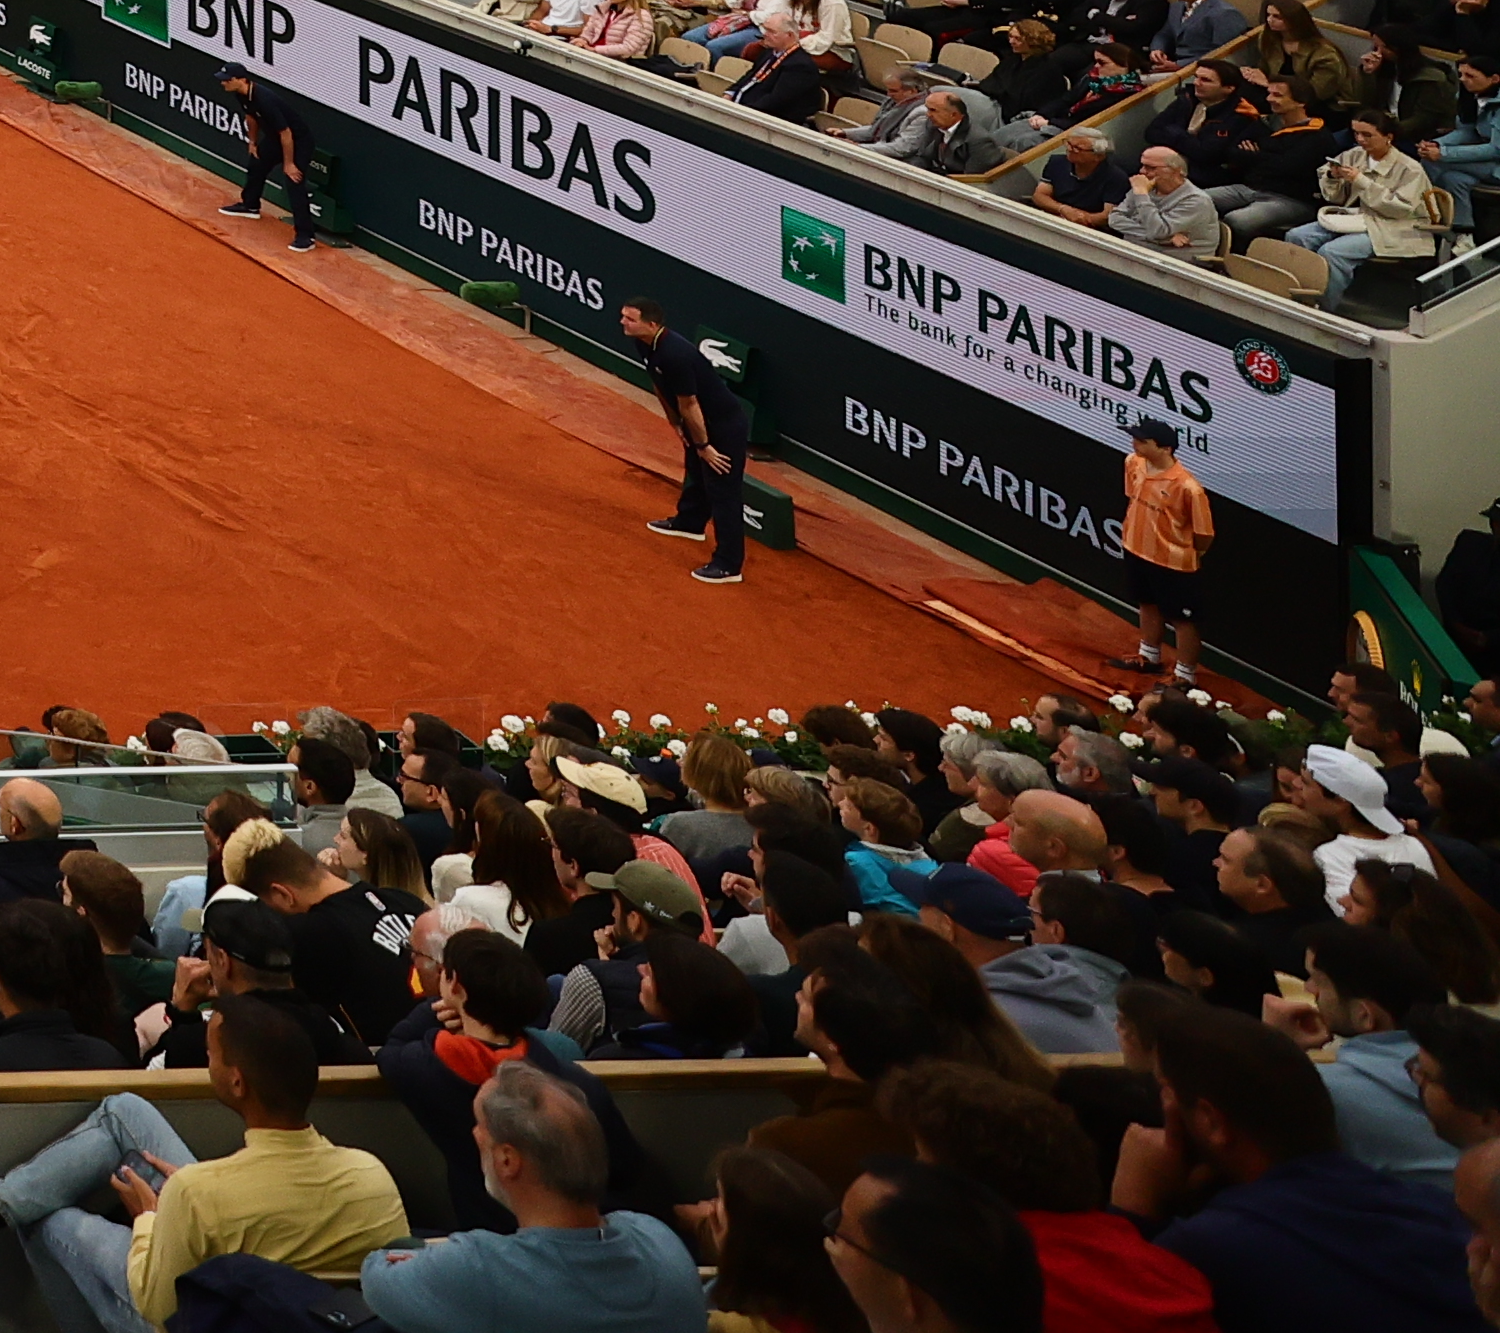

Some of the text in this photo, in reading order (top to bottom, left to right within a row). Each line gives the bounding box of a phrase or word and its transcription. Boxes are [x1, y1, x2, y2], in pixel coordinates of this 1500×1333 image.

[17, 56, 52, 80] LACOSTE
[125, 61, 165, 100] BNP
[358, 35, 656, 225] PARIBAS
[419, 199, 604, 312] BNP PARIBAS
[864, 243, 1214, 423] BNP PARIBAS
[864, 293, 900, 323] The
[908, 310, 956, 349] bank
[964, 334, 996, 363] for
[1004, 356, 1016, 372] a
[1023, 363, 1129, 425] changing
[844, 395, 927, 460] BNP
